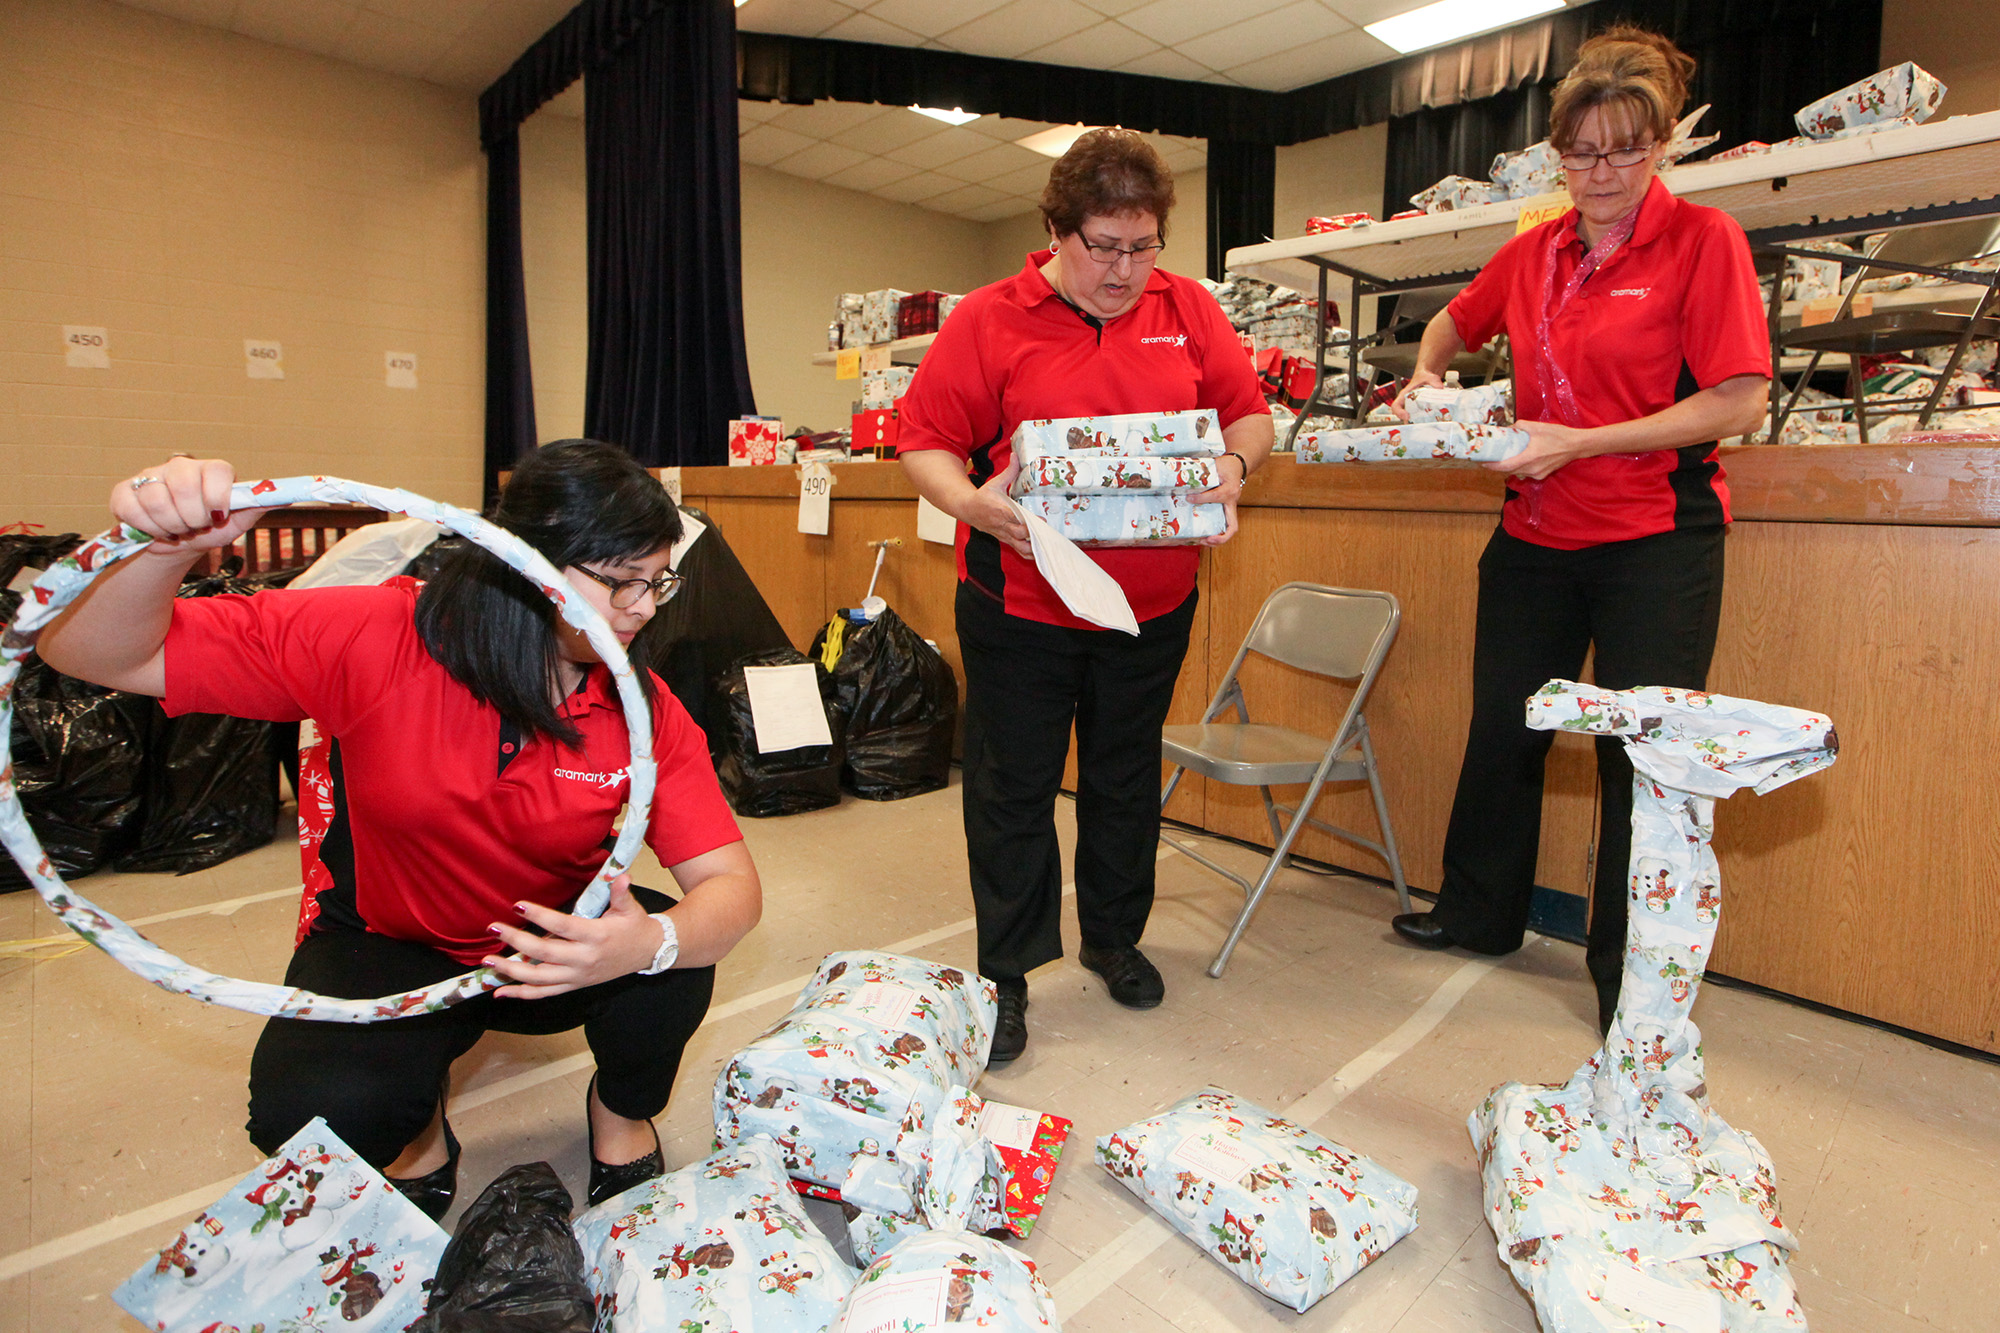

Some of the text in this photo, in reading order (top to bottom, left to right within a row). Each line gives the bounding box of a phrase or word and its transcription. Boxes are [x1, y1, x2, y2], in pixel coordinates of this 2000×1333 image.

[1609, 288, 1645, 297] aramark
[69, 334, 104, 347] 450
[1140, 335, 1176, 344] aramark
[249, 347, 279, 360] 460
[389, 359, 415, 370] 470
[804, 477, 827, 496] 490
[553, 767, 607, 784] aramark
